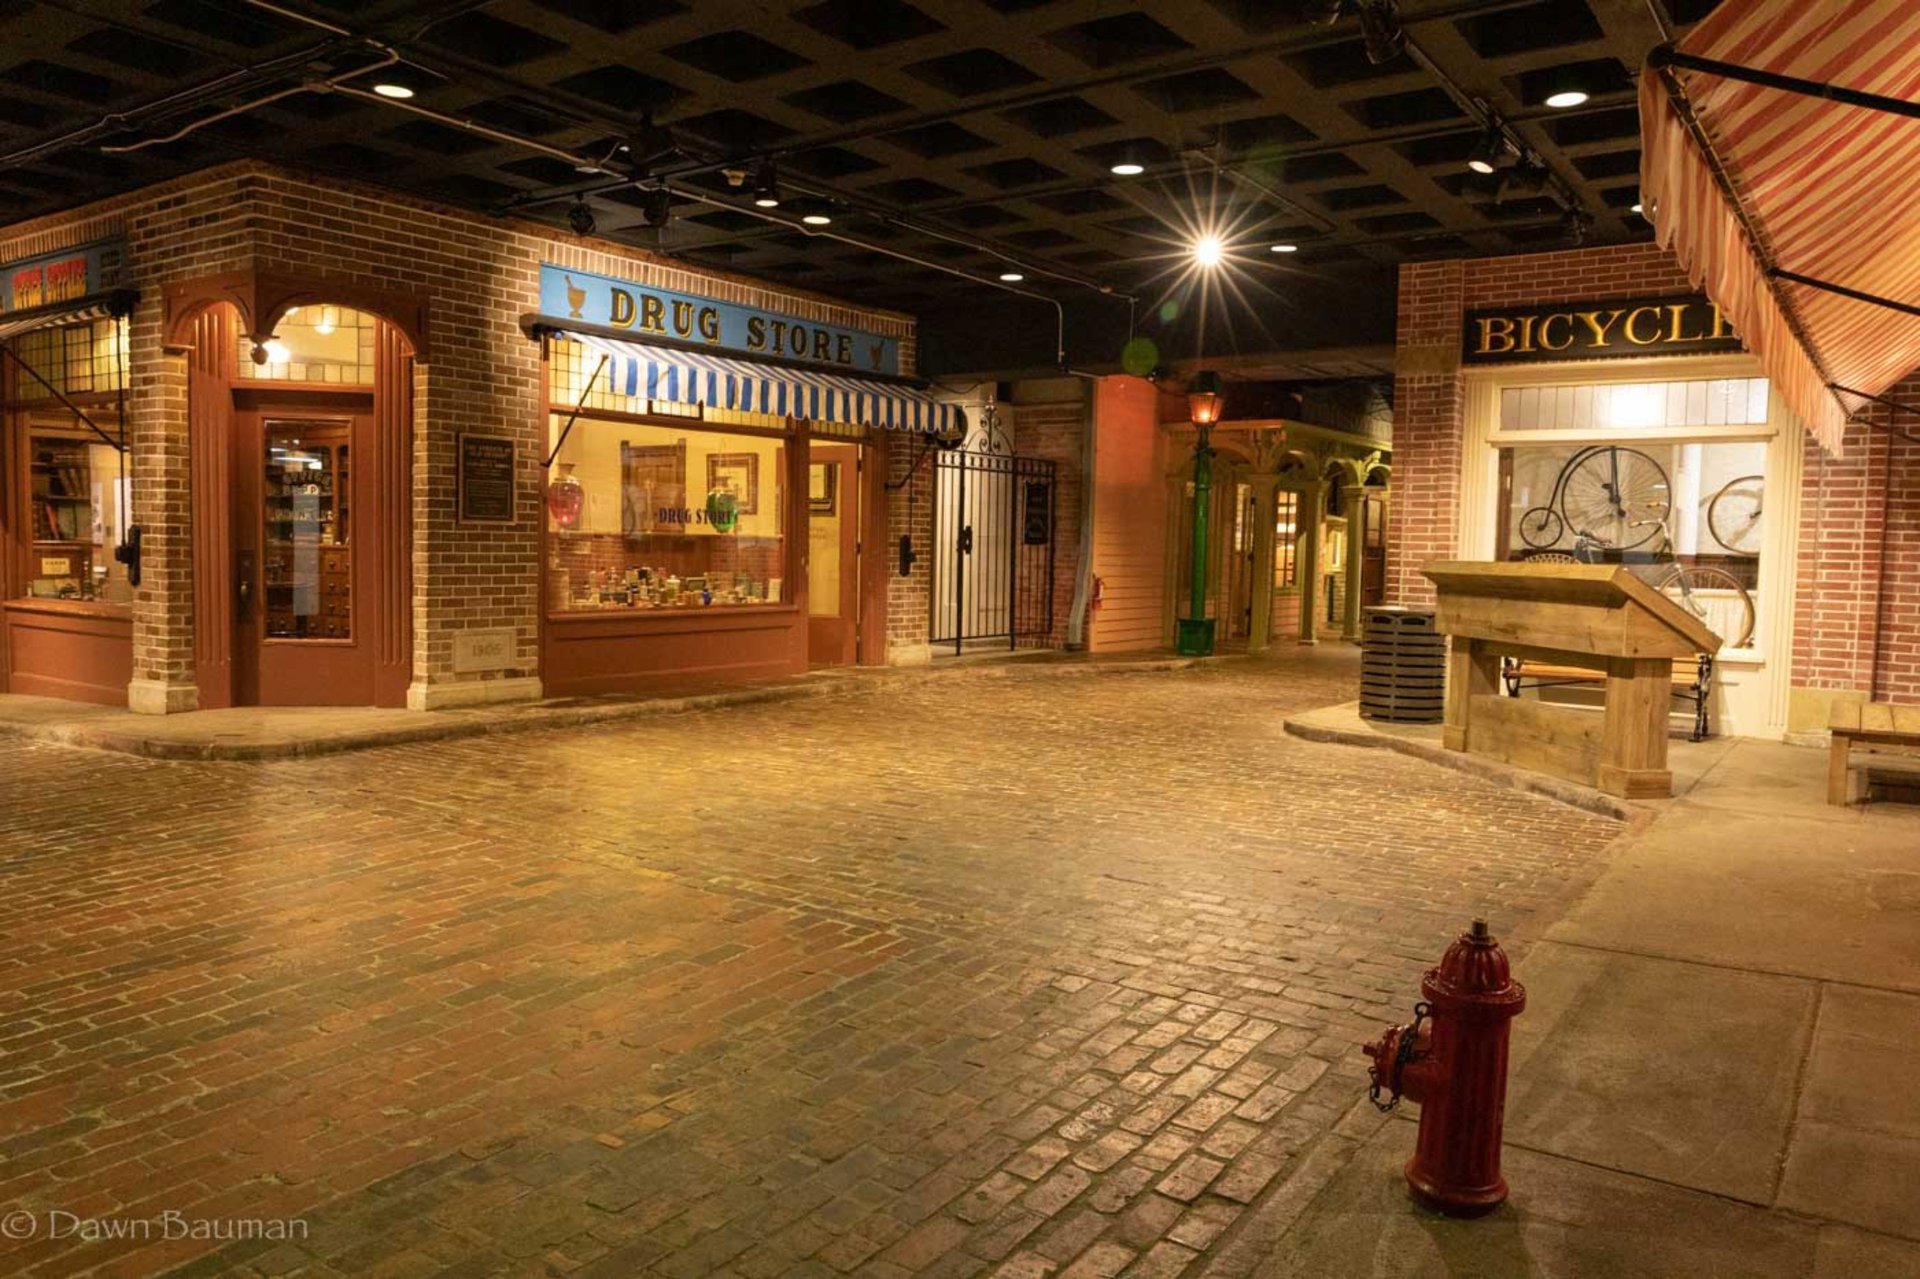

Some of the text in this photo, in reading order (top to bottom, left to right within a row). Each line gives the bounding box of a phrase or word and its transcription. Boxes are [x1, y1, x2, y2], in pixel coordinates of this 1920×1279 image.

[609, 287, 852, 365] DRUG STORE
[659, 507, 692, 525] DRUG
